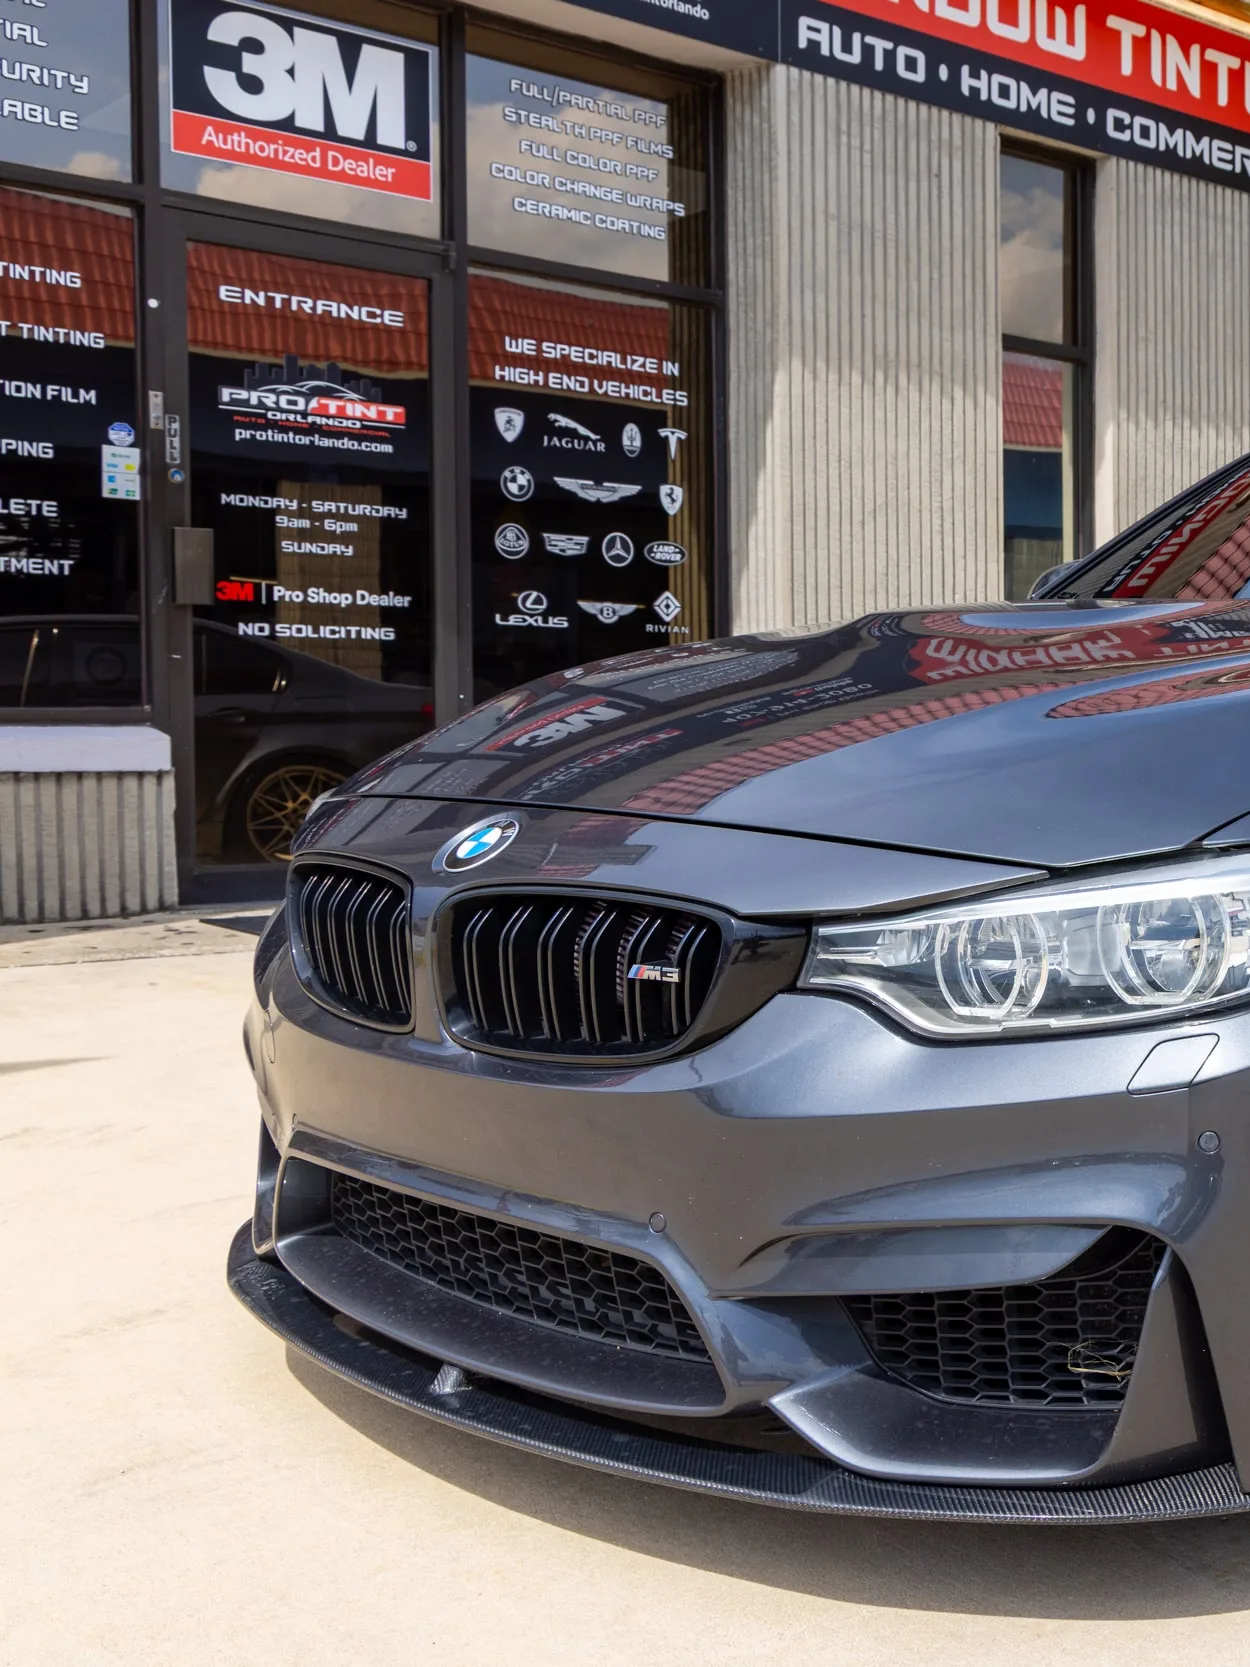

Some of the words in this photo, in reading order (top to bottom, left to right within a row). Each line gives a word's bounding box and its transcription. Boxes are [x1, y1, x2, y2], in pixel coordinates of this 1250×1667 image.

[0, 19, 48, 47] IAL
[798, 16, 925, 83] AUTO
[960, 64, 1076, 126] HOME
[0, 99, 79, 131] ABLE
[511, 79, 630, 121] FULL/PARTIAL
[634, 110, 667, 128] PPF
[504, 107, 586, 137] STEALTH
[589, 127, 622, 144] PPF
[626, 137, 674, 158] FILMS
[201, 126, 321, 168] Authorized
[328, 151, 396, 182] Dealer
[521, 141, 561, 161] FULL
[566, 151, 621, 175] COLOR
[626, 164, 658, 181] PPF
[491, 163, 550, 188] COLOR
[554, 176, 623, 203] CHANGE
[627, 193, 686, 216] WRAPS
[514, 197, 591, 224] CERAMIC
[595, 214, 666, 239] COATING
[219, 285, 404, 327] ENTRANCE
[18, 323, 105, 349] TINTING
[505, 336, 537, 355] WE
[542, 342, 658, 373] SPECIALIZE
[662, 360, 680, 376] IN
[0, 379, 41, 399] ION
[46, 384, 97, 405] FILM
[495, 365, 543, 386] HIGH
[548, 373, 589, 393] END
[594, 381, 688, 406] VEHICLES
[221, 388, 306, 411] PRO
[319, 398, 404, 421] TINT
[233, 415, 266, 424] AUTO
[267, 411, 362, 429] ORLANDO
[1, 438, 54, 459] PING
[167, 415, 179, 462] PULL
[235, 428, 393, 454] protintorlando.com
[543, 435, 606, 452] JAGUAR
[220, 493, 298, 510] MONDAY
[312, 501, 407, 519] SATURDAY
[275, 516, 310, 528] 9am
[324, 520, 358, 534] 6pm
[281, 541, 354, 556] SUNDAY
[655, 553, 682, 562] ROVER
[216, 581, 254, 601] 3M
[273, 586, 304, 602] Pro
[307, 587, 352, 607] Shop
[356, 590, 412, 607] Dealer
[238, 622, 270, 637] NO
[275, 623, 396, 640] SOLICITING
[495, 613, 569, 628] LEXUS
[645, 624, 690, 634] RIVIAN
